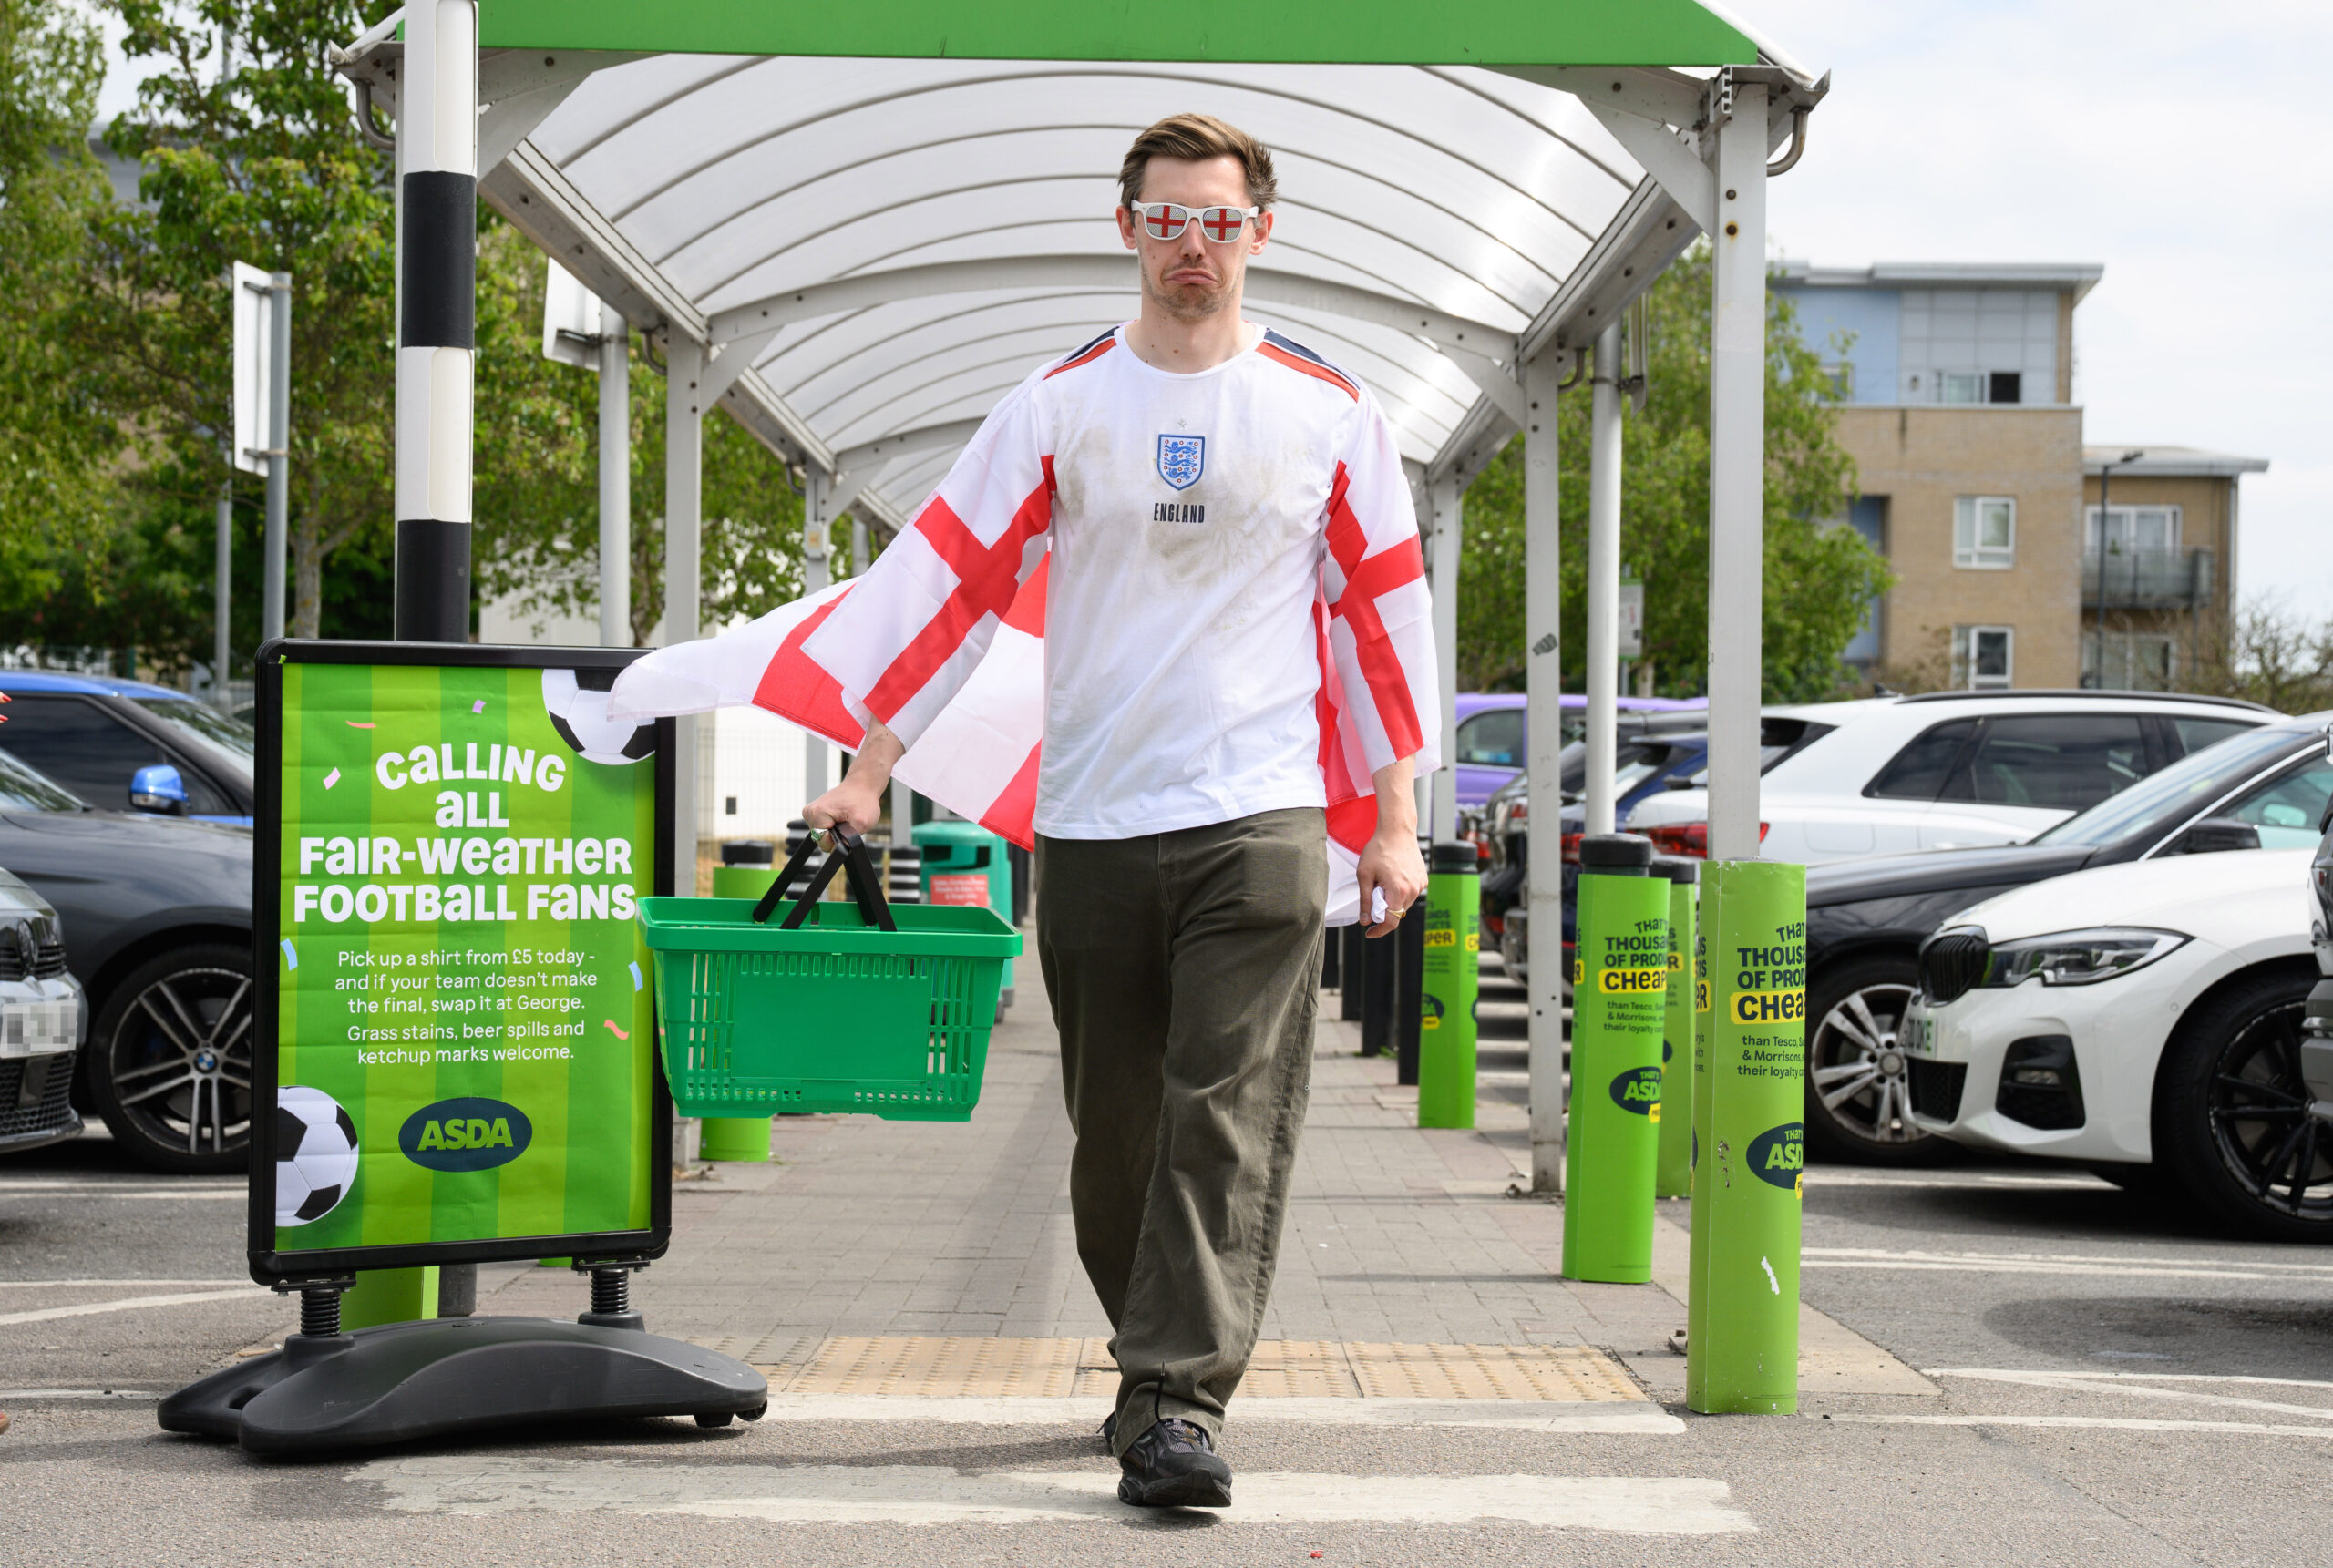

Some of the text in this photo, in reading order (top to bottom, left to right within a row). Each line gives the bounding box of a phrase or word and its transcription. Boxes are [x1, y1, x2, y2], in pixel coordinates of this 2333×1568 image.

[1154, 503, 1205, 523] ENGLAND
[376, 743, 566, 793] CaLLING
[435, 791, 509, 828] aLL
[300, 836, 632, 875] FaIR-WeaTHeR
[294, 883, 636, 922] FOOTBaLL FaNS
[339, 950, 375, 967] Pick
[380, 953, 402, 969] up
[406, 954, 416, 966] a
[421, 948, 460, 966] shirt
[466, 948, 508, 966] from
[513, 948, 532, 964] £5
[537, 948, 584, 968] today
[1605, 954, 1626, 968] OF
[335, 970, 598, 993] and if your team doesn’t make
[1737, 970, 1766, 989] OF
[348, 993, 585, 1016] the final, swap it at George.
[1608, 1001, 1629, 1009] than
[348, 1020, 585, 1042] Grass stains, beer spills and
[1604, 1022, 1626, 1031] their
[1629, 1023, 1653, 1034] loyalty
[1742, 1035, 1770, 1046] than
[1773, 1036, 1798, 1048] Tesco,
[358, 1042, 574, 1067] ketchup marks welcome.
[1742, 1050, 1752, 1061] &
[1737, 1065, 1767, 1075] their
[1770, 1066, 1798, 1079] loyalty
[1623, 1081, 1660, 1101] ASD
[417, 1117, 514, 1151] ASDA
